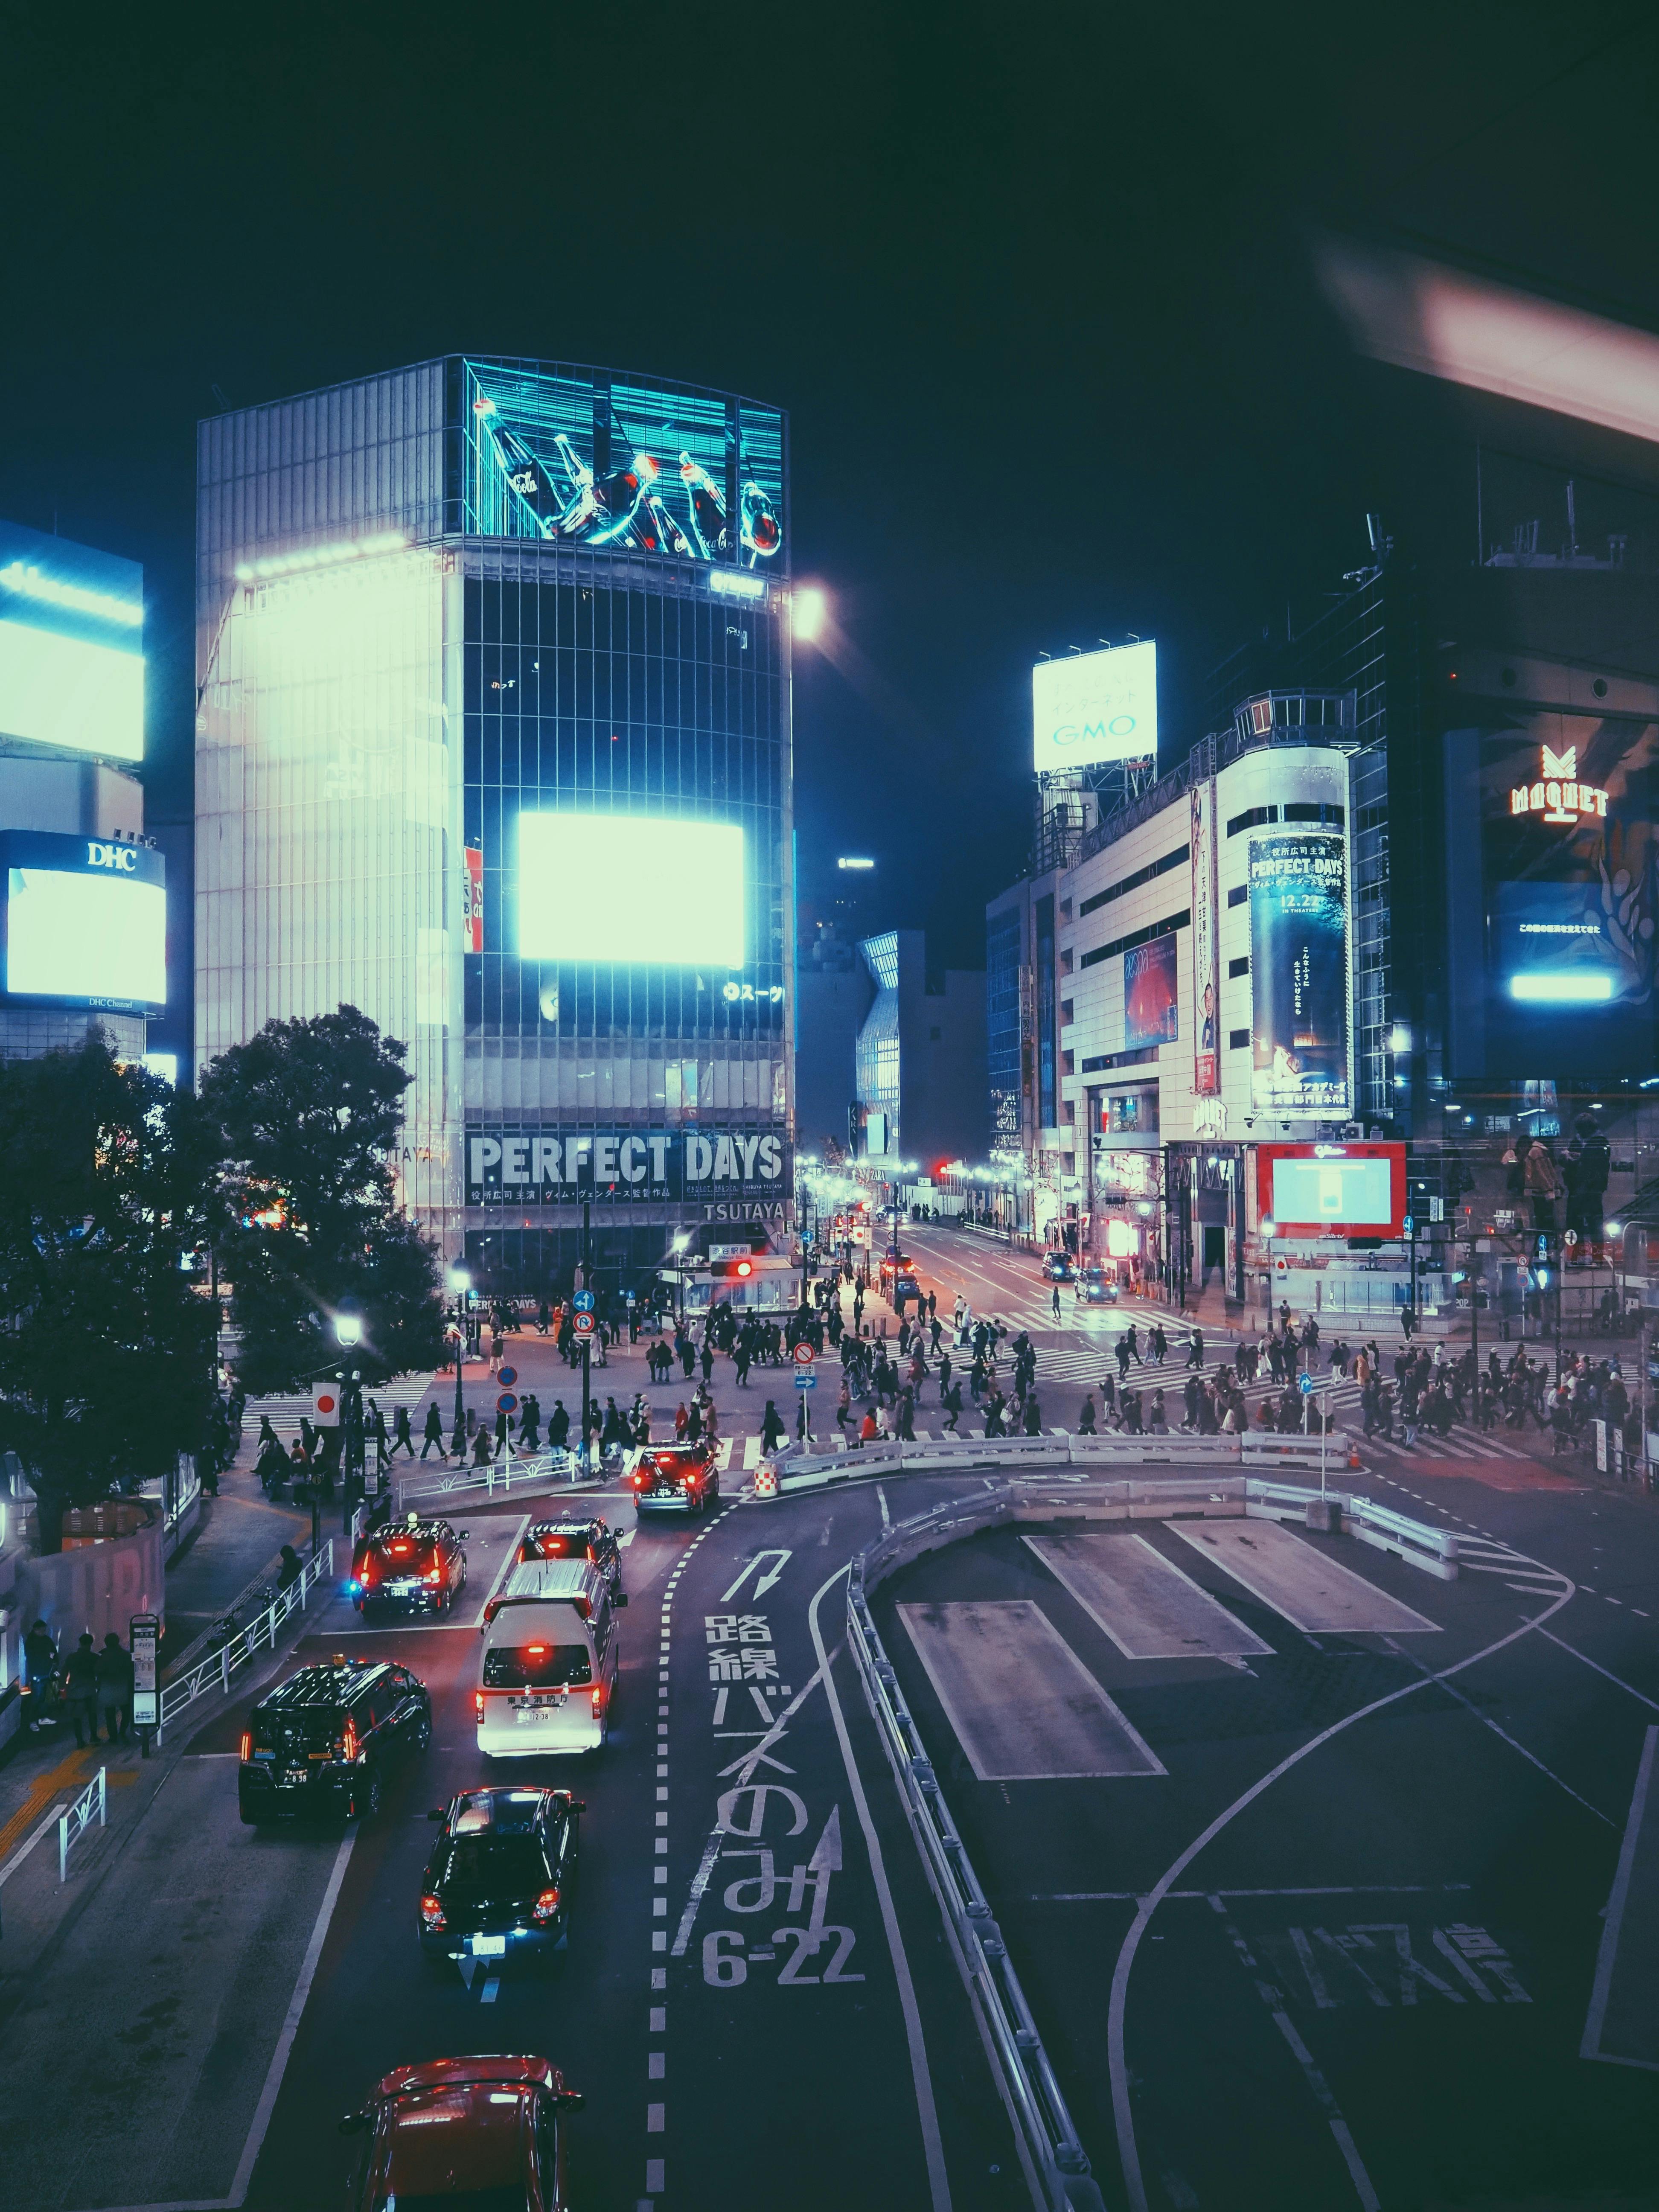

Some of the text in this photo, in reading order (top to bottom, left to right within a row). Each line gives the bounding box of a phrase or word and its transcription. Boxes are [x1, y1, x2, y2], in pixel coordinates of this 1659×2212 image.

[1053, 715, 1136, 745] GMO
[87, 843, 137, 871] DHC
[1272, 847, 1307, 856] 役所広司
[1252, 858, 1343, 878] PERFECT DAYS
[1281, 894, 1318, 907] 12.22
[1125, 949, 1149, 987] aespa
[1302, 946, 1310, 987] こんなふうに
[89, 998, 133, 1009] DHC Channel
[471, 1136, 671, 1183] PERFECT
[686, 1135, 782, 1180] DAYS
[871, 1170, 885, 1181] ZARA
[472, 1188, 670, 1200] 役所広司 主演 ヴィム・ヴェンダース監督作品
[704, 1202, 784, 1221] TSUTAYA
[713, 1247, 747, 1255] 渋谷駅前
[508, 1694, 569, 1705] 東京消防庁
[704, 1615, 820, 1913] 路線バスのみ
[702, 1925, 865, 1988] 6-22
